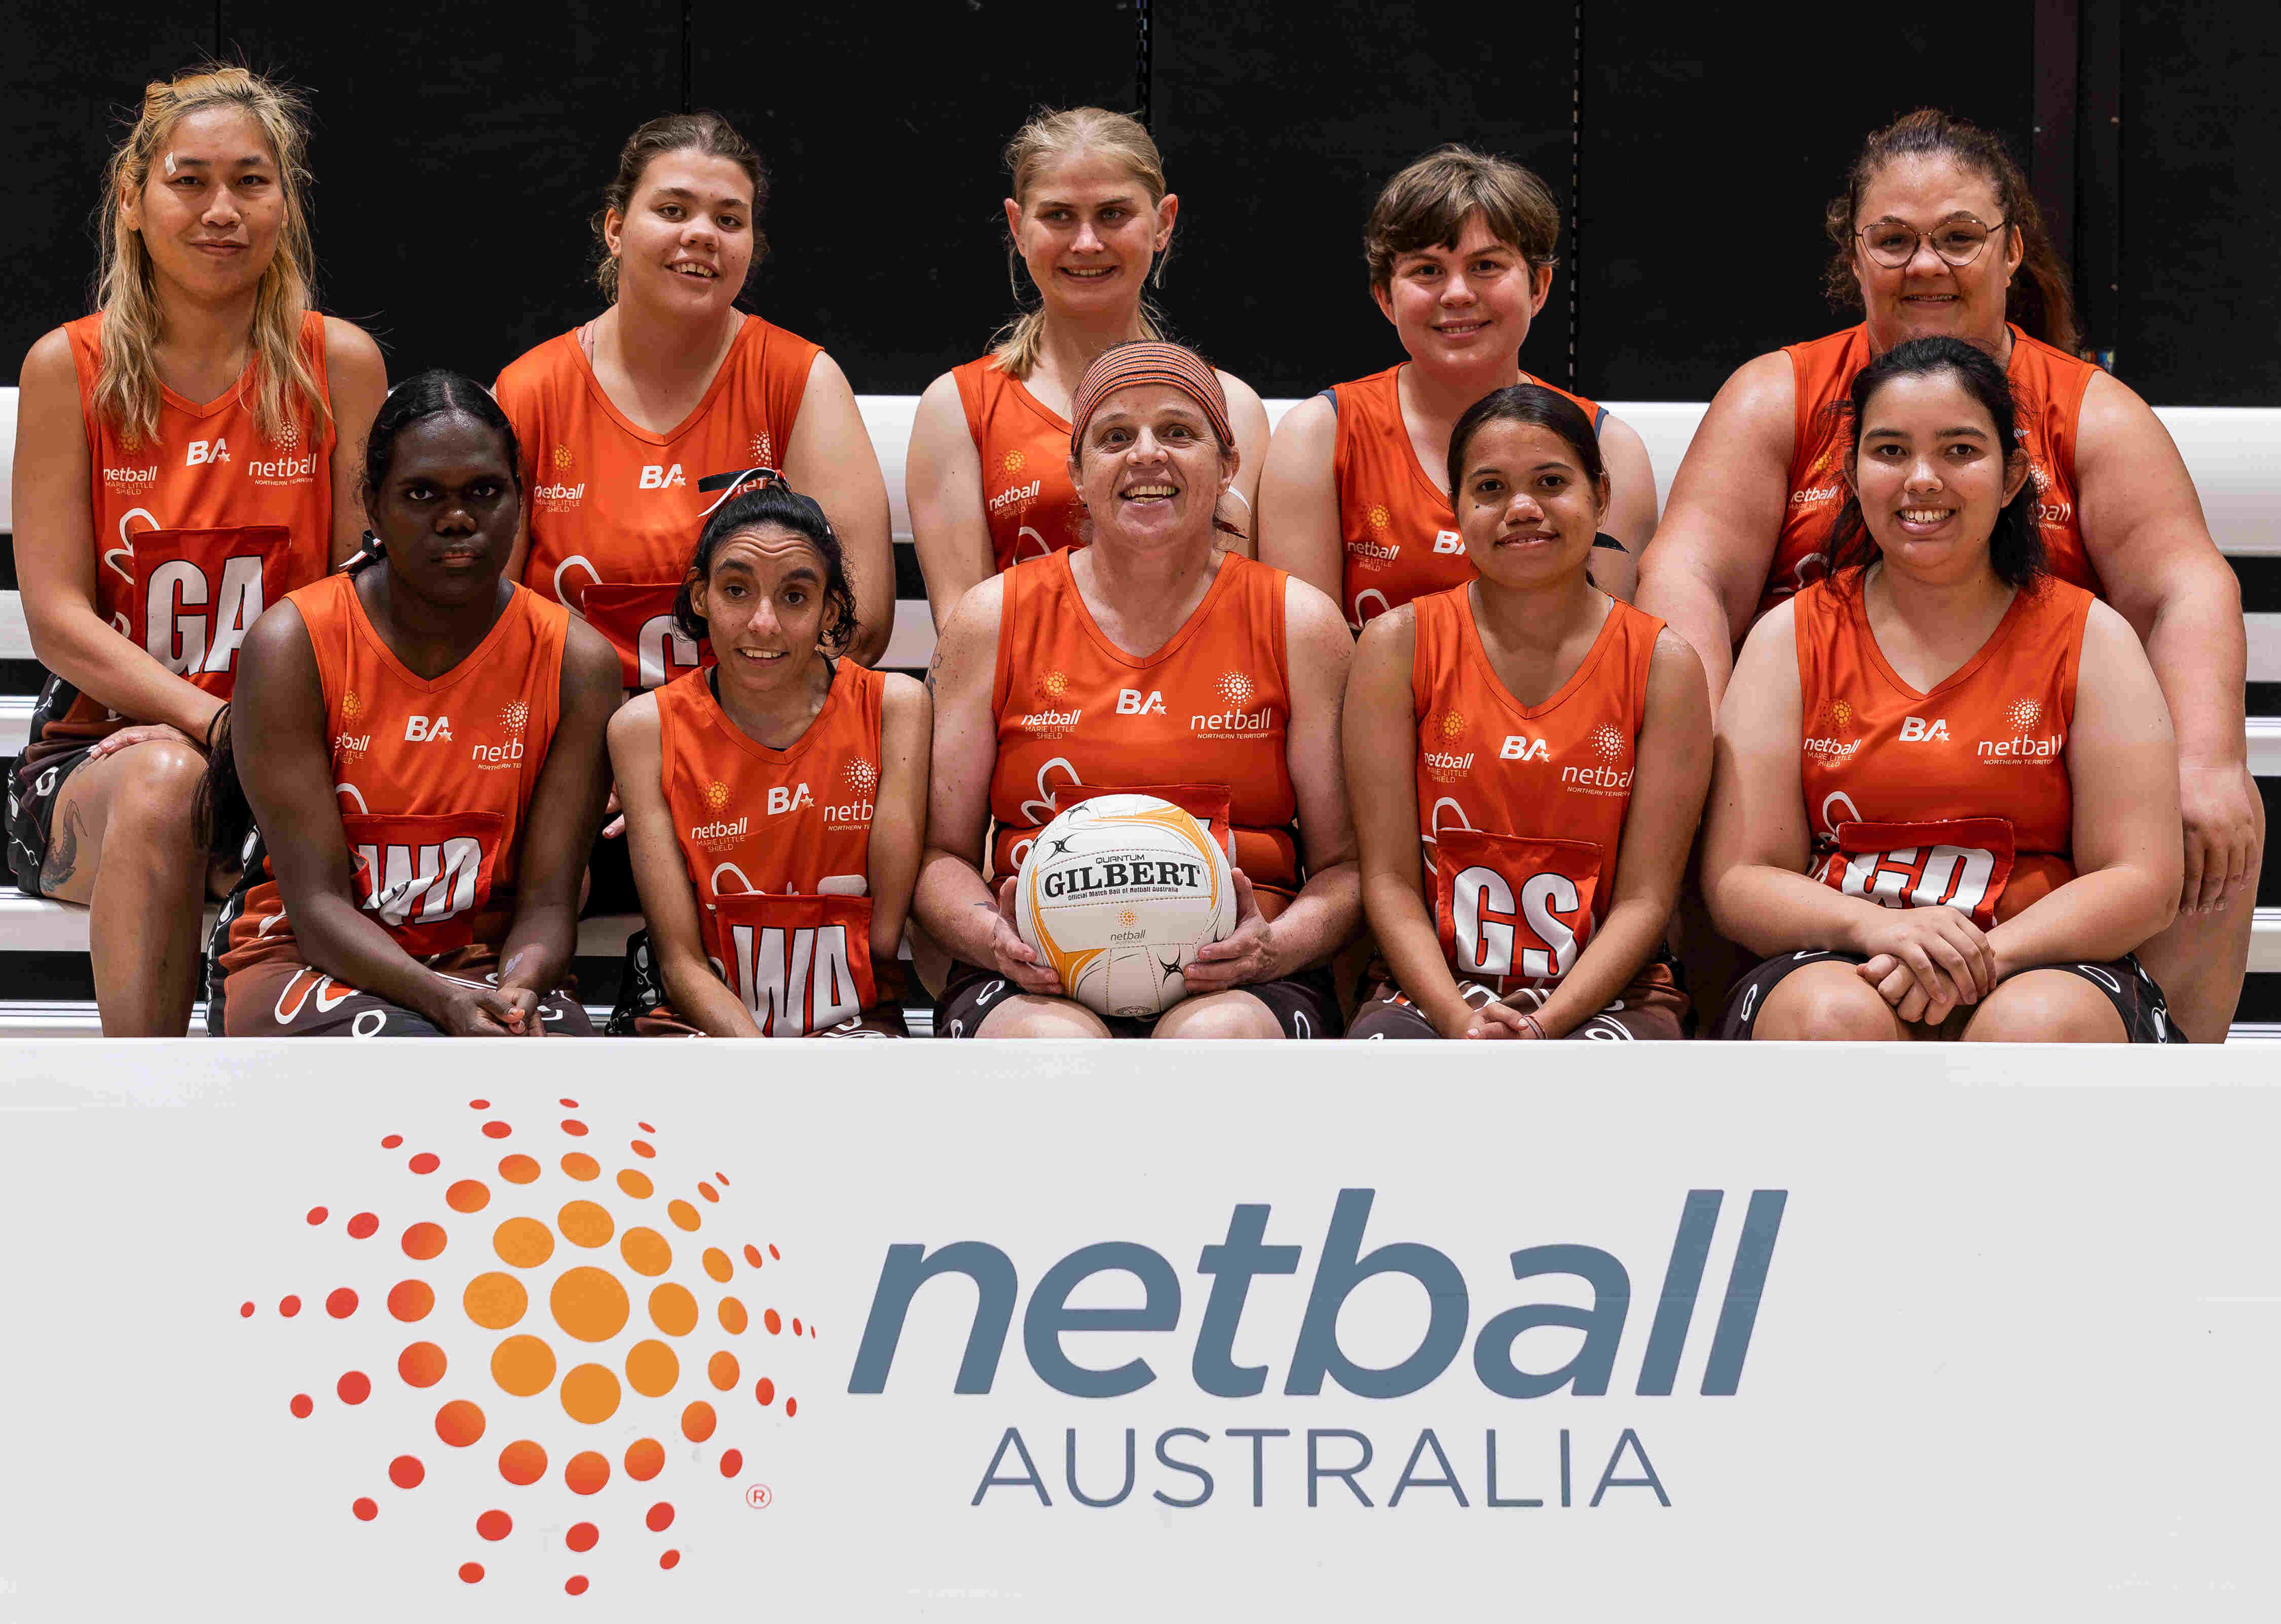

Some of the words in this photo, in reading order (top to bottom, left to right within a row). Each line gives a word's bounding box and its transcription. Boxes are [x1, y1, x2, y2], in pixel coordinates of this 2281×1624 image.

[103, 466, 158, 482] netball
[248, 453, 317, 478] netball
[639, 463, 687, 489] BA
[534, 483, 585, 499] netball
[989, 479, 1041, 511] netball
[1347, 541, 1400, 560] netball
[146, 555, 265, 675] GA
[1115, 689, 1167, 715] BA
[404, 715, 453, 742] BA
[1021, 709, 1082, 726] netball
[1190, 707, 1271, 730] netball
[1898, 716, 1951, 743] BA
[334, 732, 370, 751] etball
[472, 737, 523, 762] netb
[1499, 735, 1552, 763] BA
[1804, 737, 1861, 754] netball
[1977, 733, 2062, 756] netball
[768, 782, 815, 815] BA
[1567, 786, 1603, 796] NORTHERN
[823, 799, 874, 822] netb
[692, 816, 747, 839] netball
[707, 843, 734, 852] SHIELD
[719, 835, 745, 845] LITTLE
[1096, 854, 1145, 864] QUANTUM
[1044, 861, 1198, 898] GILBERT
[1068, 893, 1088, 901] Official
[1451, 865, 1580, 978] GS
[1110, 929, 1146, 941] netball
[732, 924, 861, 1037] WA
[847, 1188, 1788, 1399] netball
[971, 1427, 1671, 1508] AUSTRALIA
